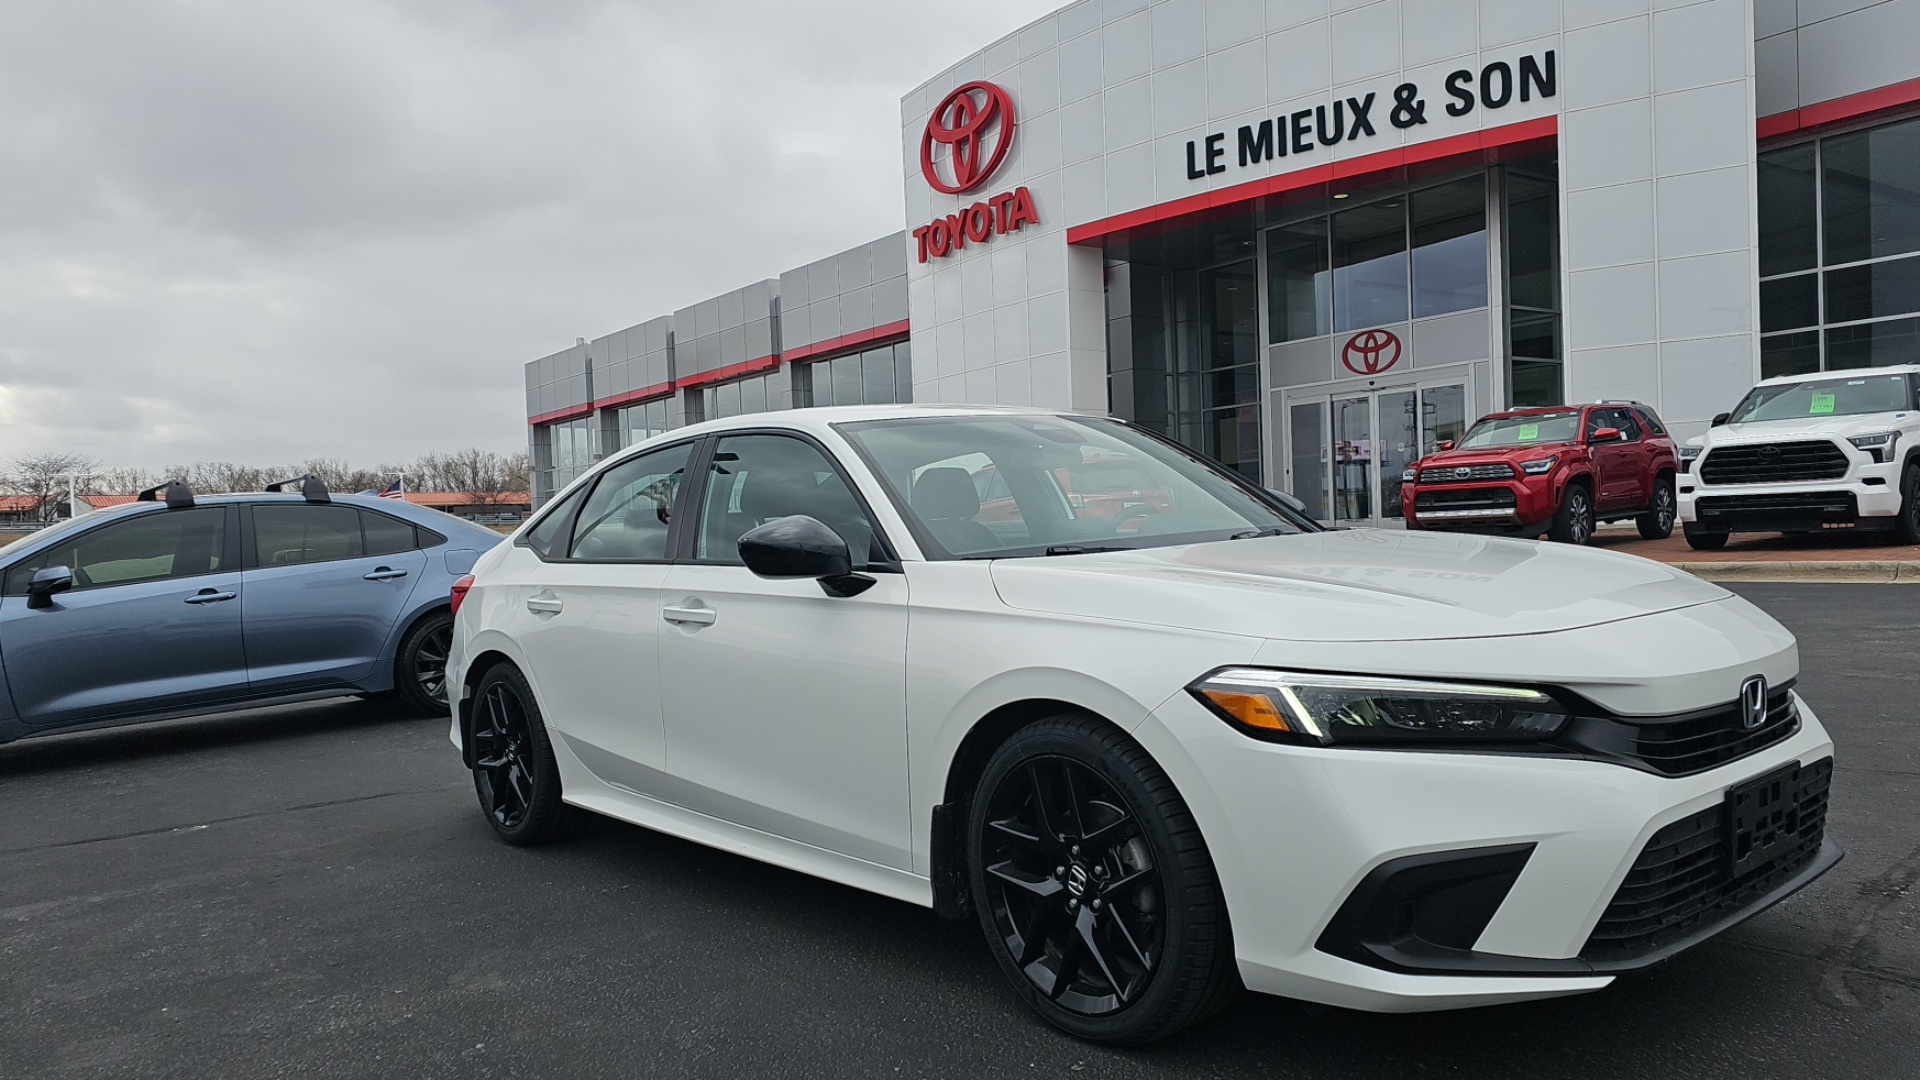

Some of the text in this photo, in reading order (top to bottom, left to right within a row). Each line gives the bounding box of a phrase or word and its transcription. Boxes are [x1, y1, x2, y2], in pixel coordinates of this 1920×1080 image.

[1186, 50, 1556, 180] LE MIEUX & SON
[913, 186, 1038, 264] TOYOTA
